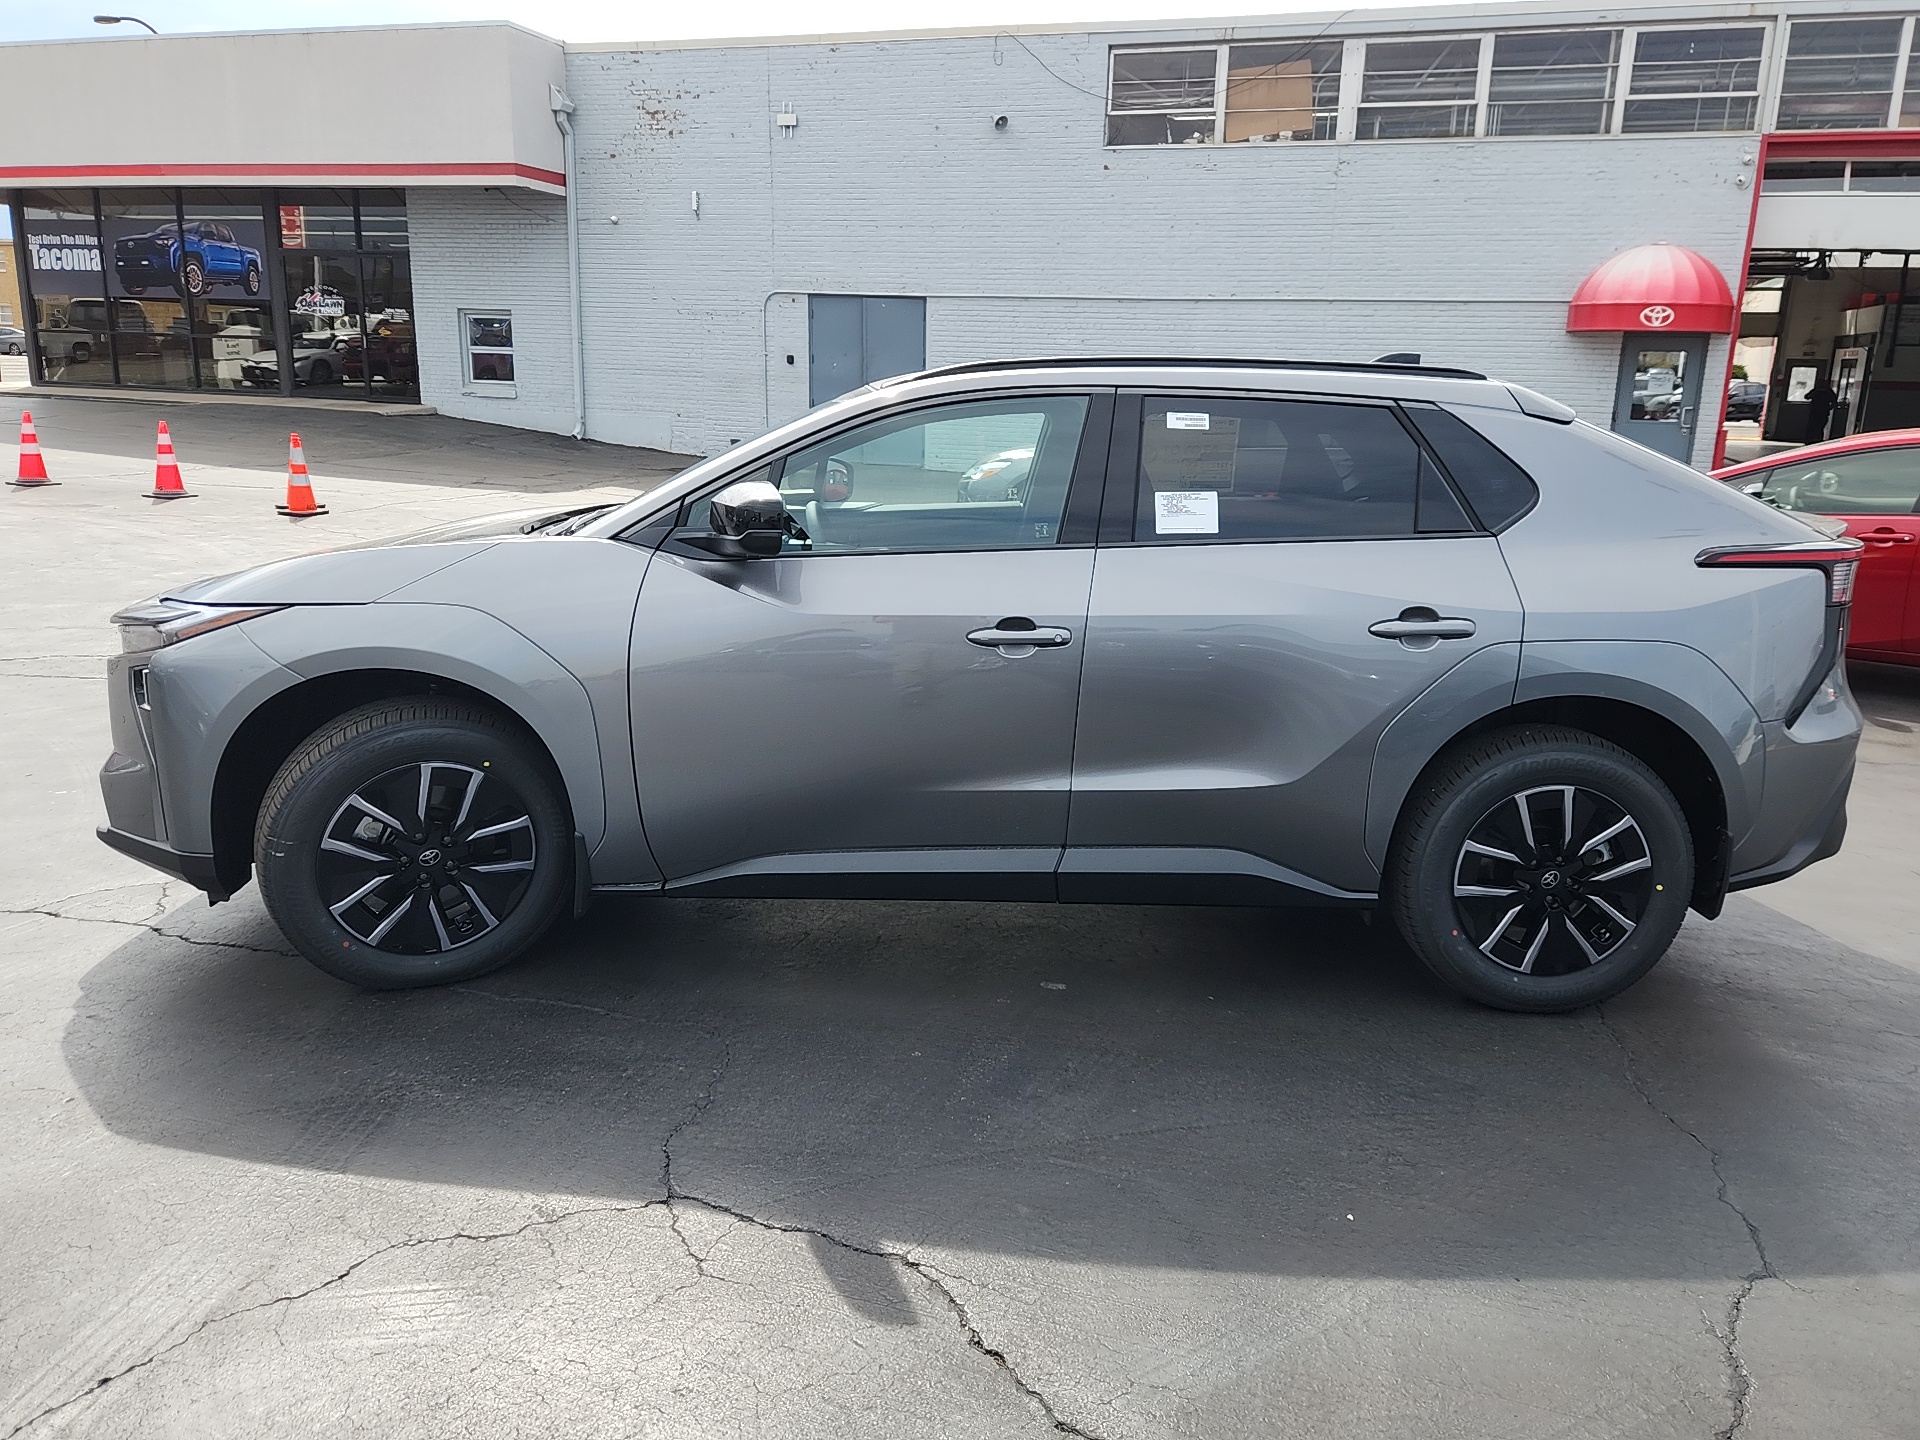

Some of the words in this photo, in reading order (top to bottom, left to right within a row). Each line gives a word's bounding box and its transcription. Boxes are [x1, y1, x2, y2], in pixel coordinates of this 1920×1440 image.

[27, 234, 42, 245] Test
[42, 234, 61, 245] Drive
[61, 234, 75, 245] The
[75, 235, 85, 246] All
[28, 244, 105, 271] Tacoma
